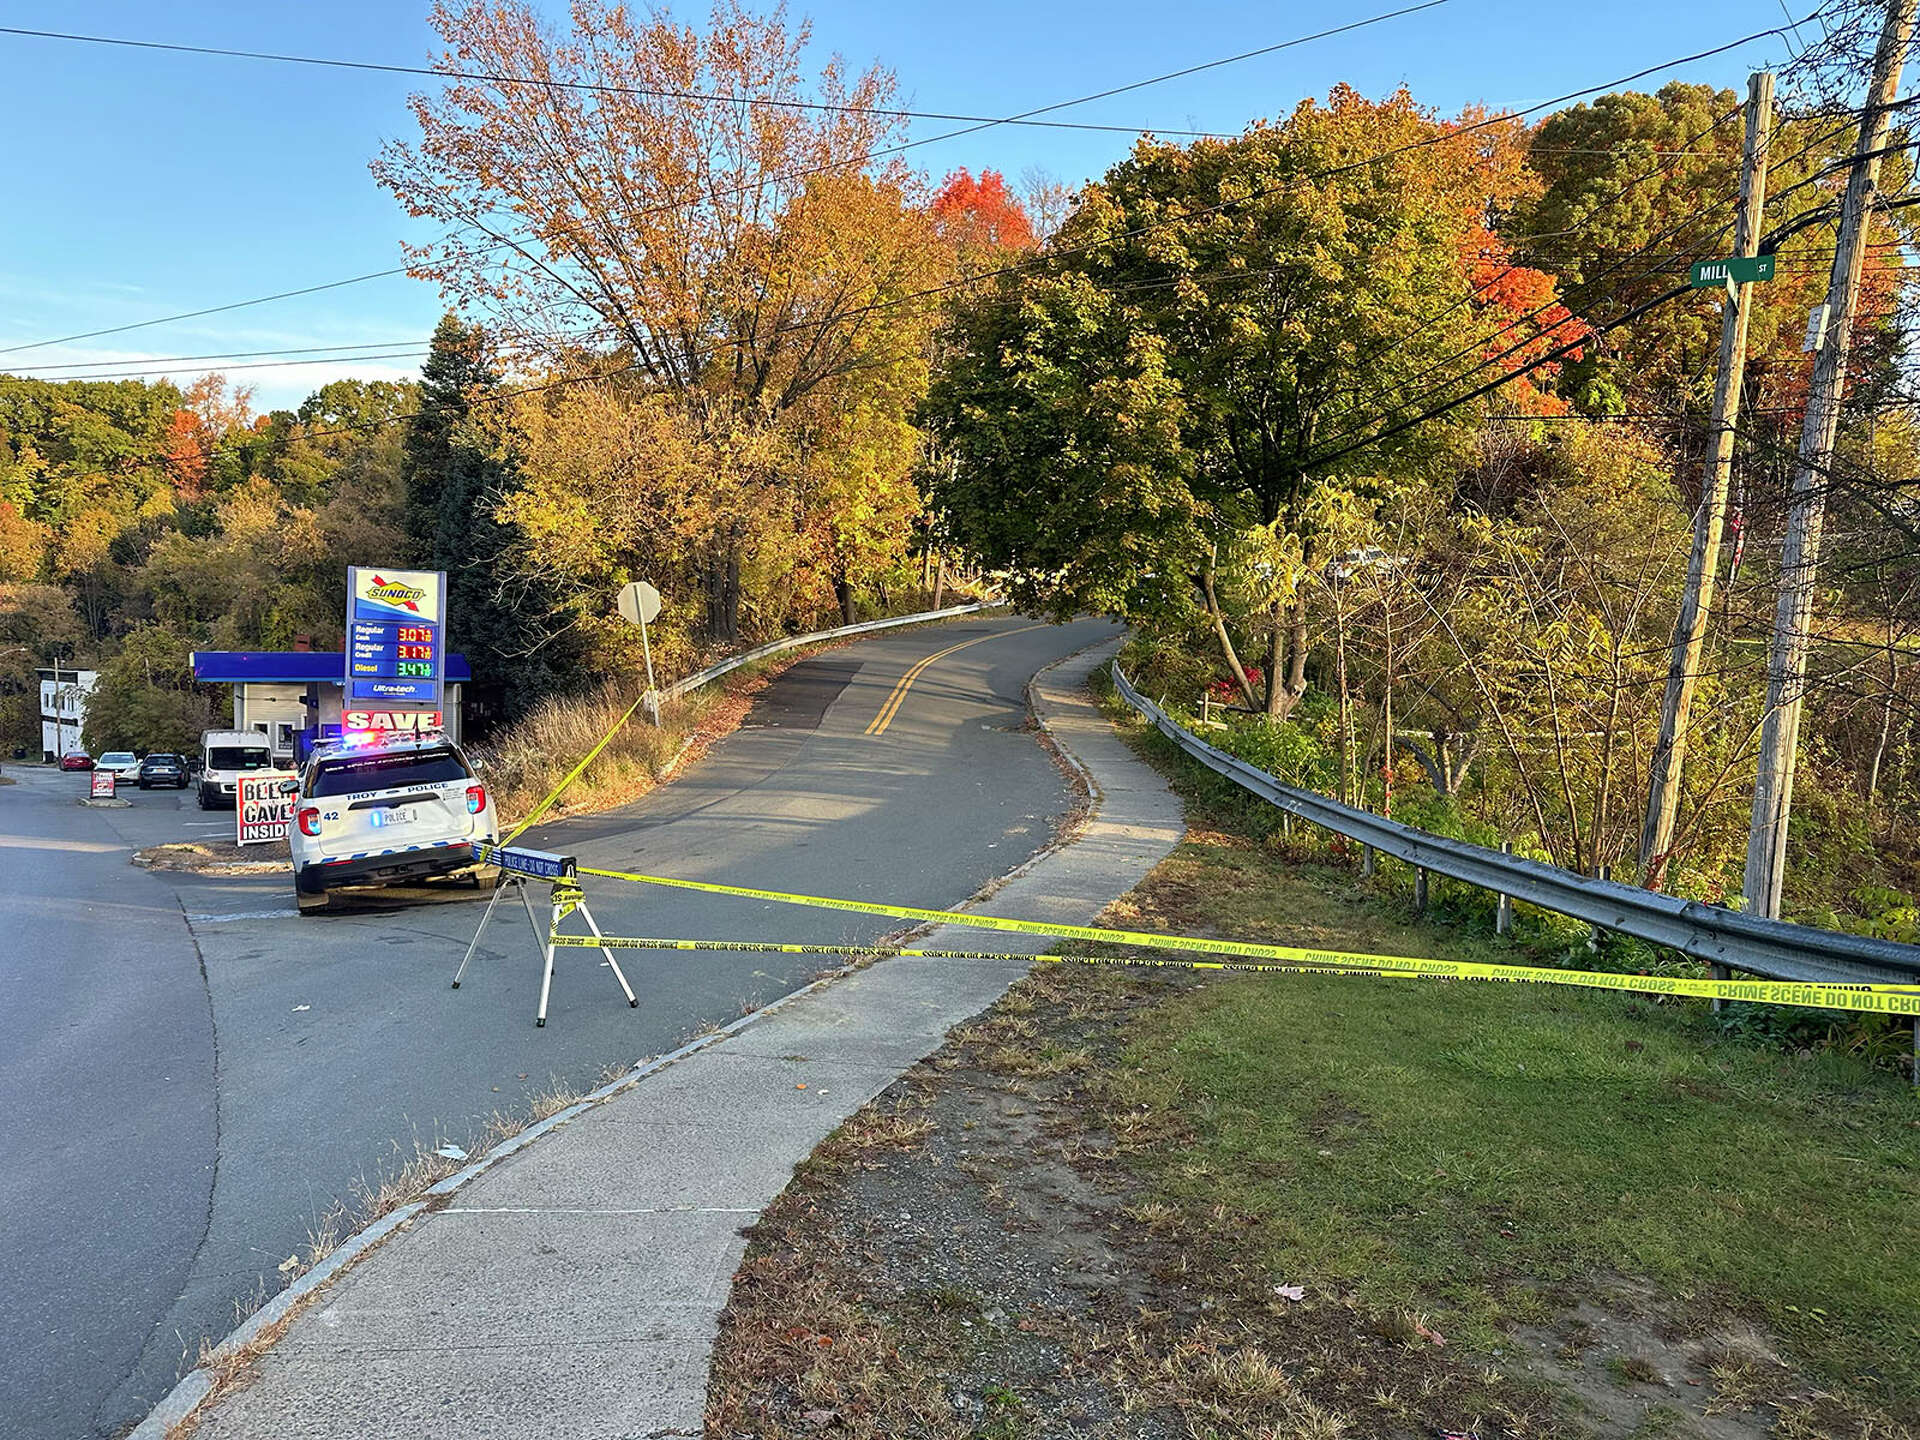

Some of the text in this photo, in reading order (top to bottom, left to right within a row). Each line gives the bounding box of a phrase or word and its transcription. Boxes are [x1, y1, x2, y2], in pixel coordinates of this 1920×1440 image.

[1700, 264, 1766, 280] MILL ST
[371, 588, 421, 600] SUNOCO
[355, 626, 384, 635] Regular
[355, 642, 384, 652] Regular
[354, 664, 378, 672] Diesel
[346, 712, 435, 732] SAVE
[346, 783, 449, 801] TROY POLICE
[324, 812, 339, 821] 42
[504, 854, 518, 868] POLICE
[545, 862, 559, 876] CROSS
